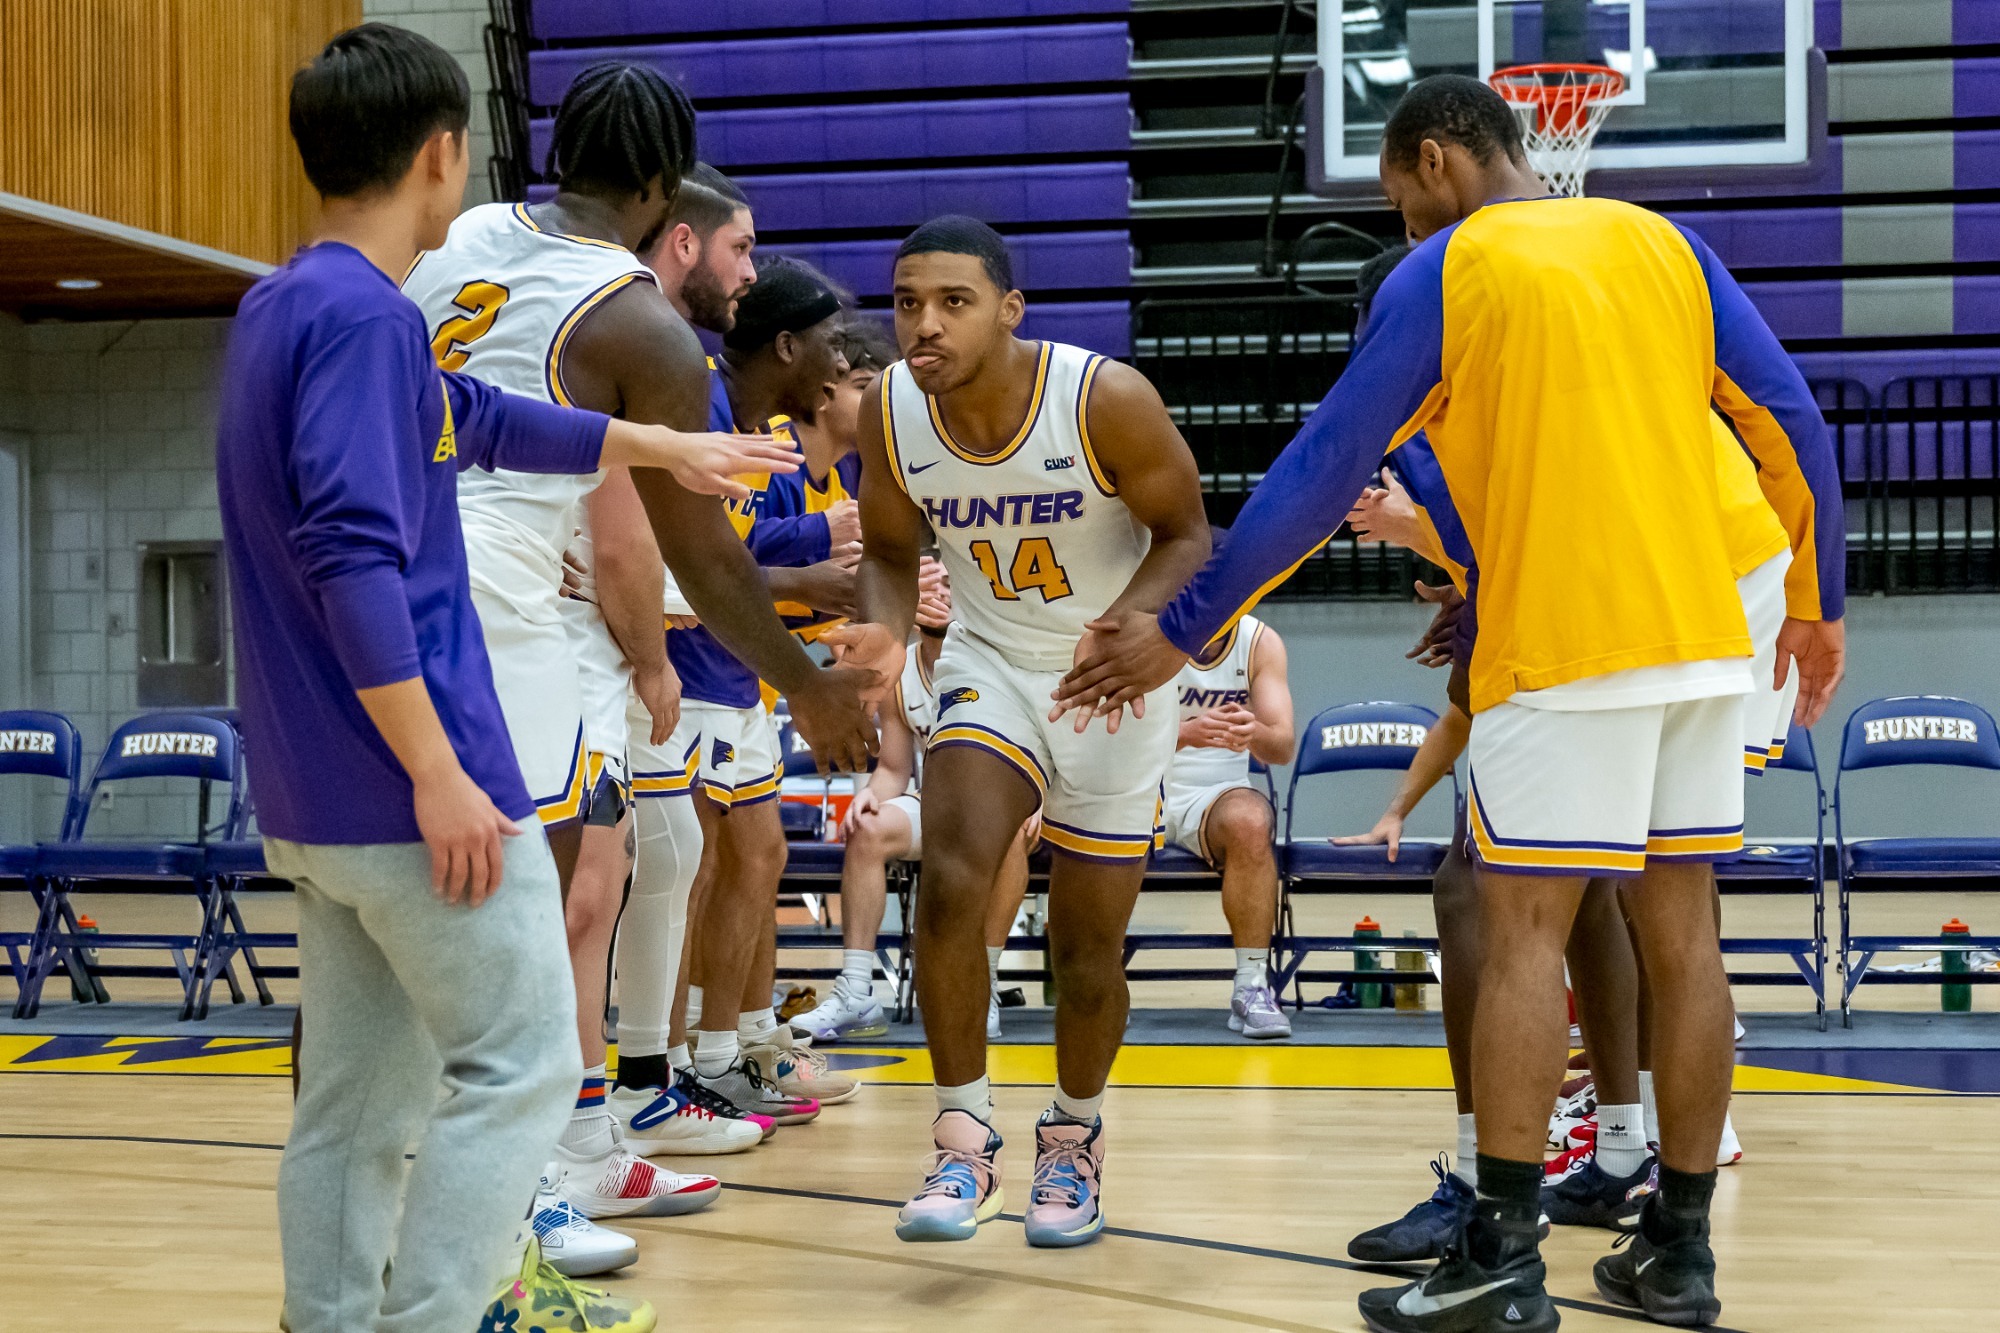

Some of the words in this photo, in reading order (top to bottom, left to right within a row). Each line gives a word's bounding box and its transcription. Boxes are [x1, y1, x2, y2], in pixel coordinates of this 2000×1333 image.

[430, 279, 511, 373] 2
[1044, 455, 1075, 471] CUNY
[921, 489, 1086, 530] HUNTER
[969, 537, 1073, 603] 14
[1322, 723, 1428, 749] HUNTER
[1864, 716, 1978, 743] HUNTER
[121, 733, 218, 757] HUNTER
